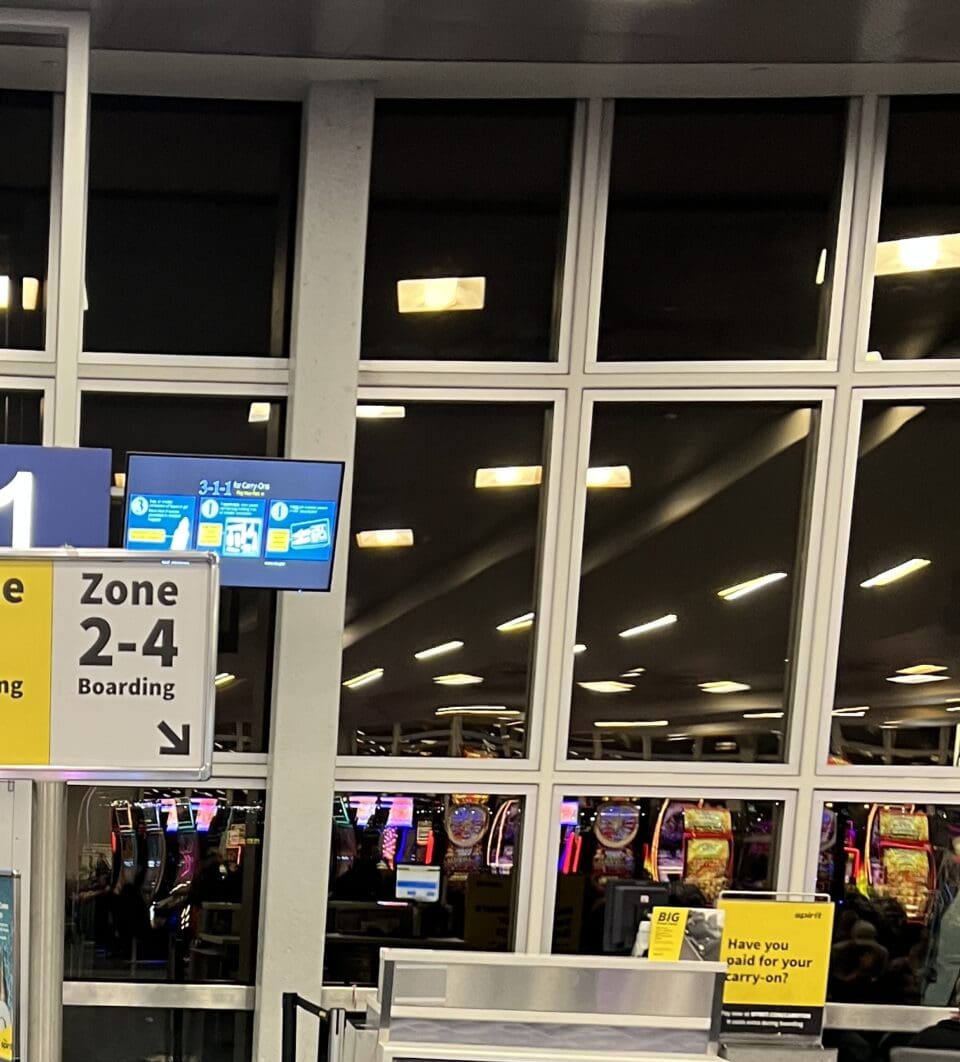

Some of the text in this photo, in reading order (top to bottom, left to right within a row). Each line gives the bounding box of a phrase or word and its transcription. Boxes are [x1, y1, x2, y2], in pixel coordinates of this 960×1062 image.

[198, 479, 232, 496] 3-1-1
[80, 572, 179, 606] Zone
[78, 616, 179, 668] 2-4
[77, 678, 176, 701] Boarding
[658, 912, 680, 922] BIG
[794, 911, 823, 920] spirit
[727, 938, 789, 954] Have you
[726, 954, 813, 971] paid for your
[725, 971, 789, 985] carry-on?
